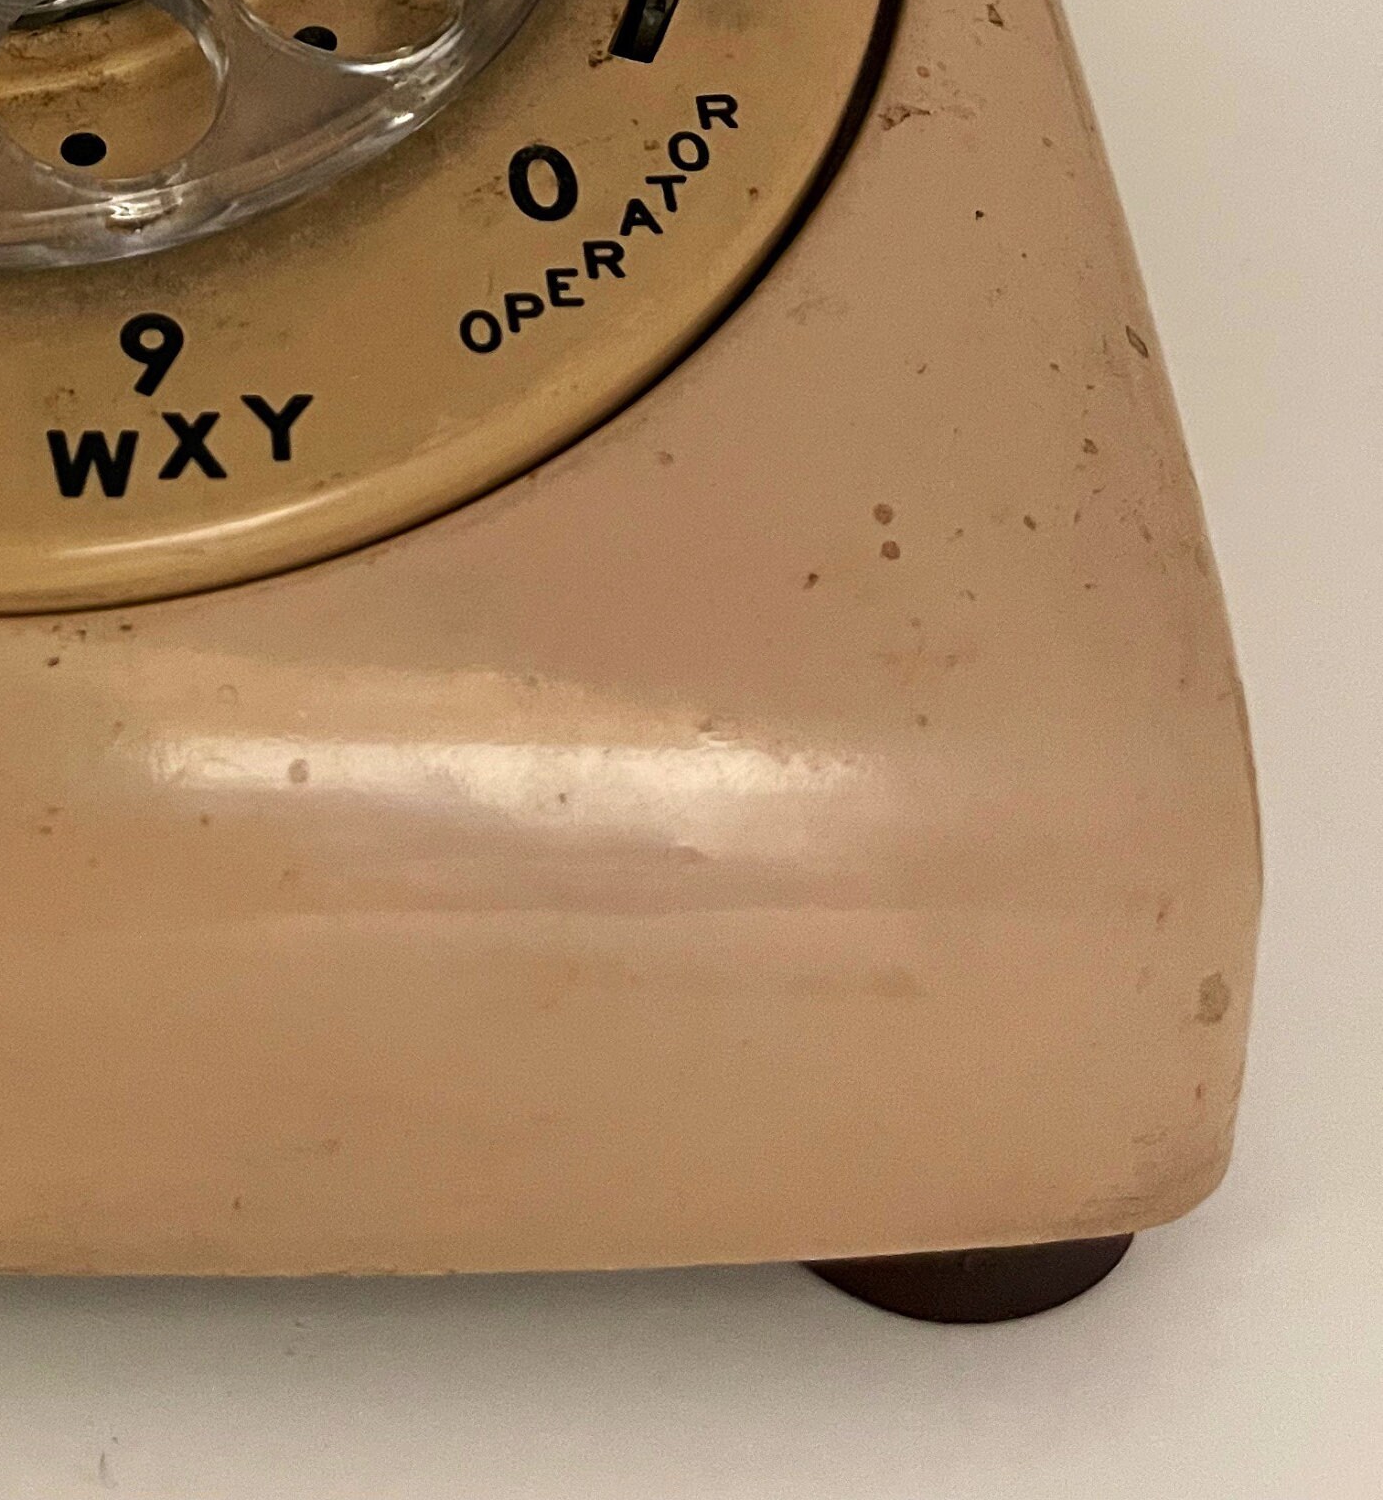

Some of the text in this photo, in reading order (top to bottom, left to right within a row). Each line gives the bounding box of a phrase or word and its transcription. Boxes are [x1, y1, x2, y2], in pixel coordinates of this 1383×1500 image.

[459, 94, 739, 354] OPERATOR
[120, 313, 185, 396] 9
[46, 394, 314, 498] WXY
